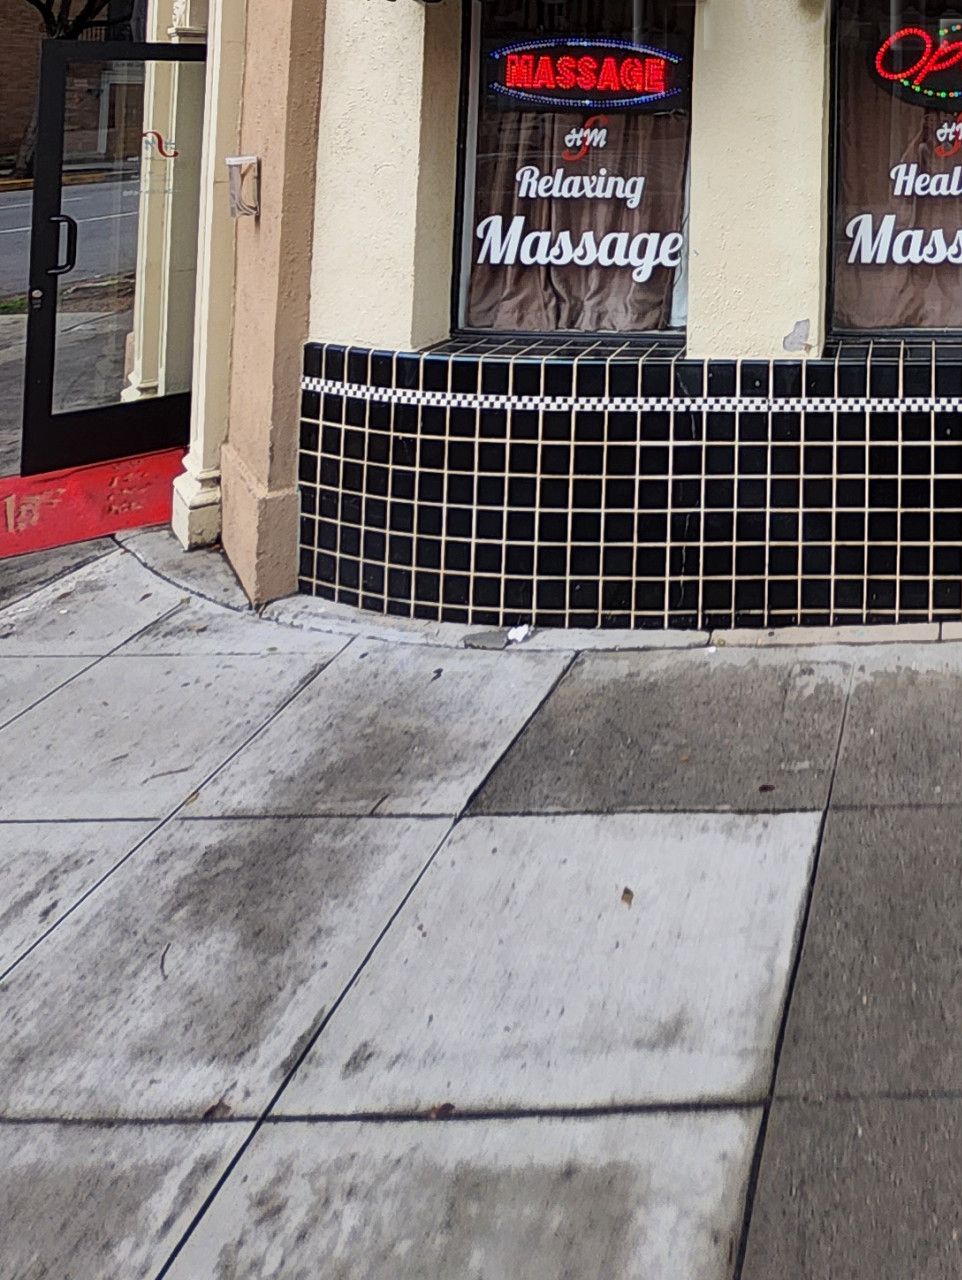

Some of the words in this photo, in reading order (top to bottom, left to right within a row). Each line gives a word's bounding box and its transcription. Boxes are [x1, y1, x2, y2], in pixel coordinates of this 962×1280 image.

[505, 55, 666, 93] MASSAGE
[516, 165, 645, 209] Relaxing
[476, 215, 684, 283] Massage
